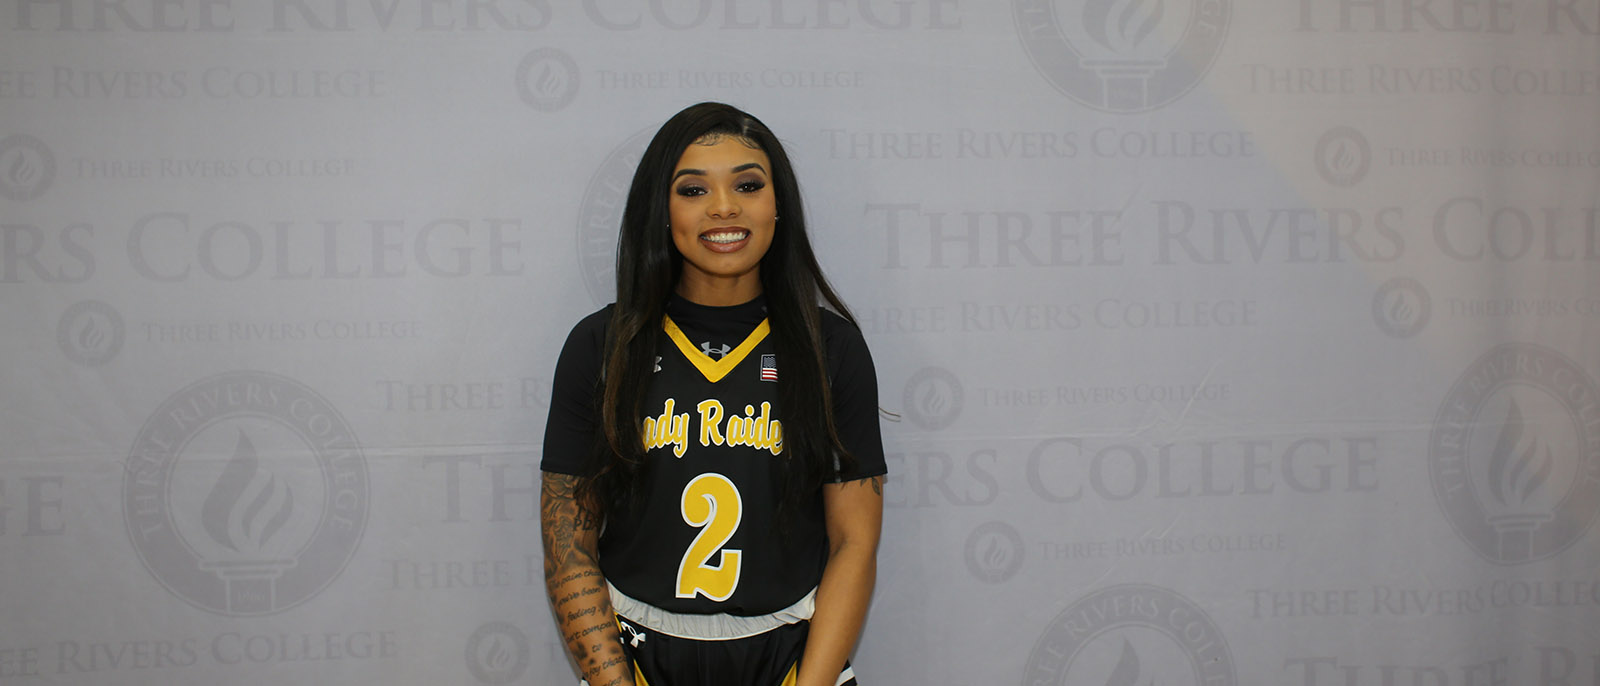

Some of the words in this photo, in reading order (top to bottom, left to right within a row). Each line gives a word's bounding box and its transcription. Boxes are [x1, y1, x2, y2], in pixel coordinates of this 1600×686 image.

[10, 0, 236, 33] HREE
[52, 66, 189, 100] RIVERS
[201, 66, 386, 99] COLLEGE
[596, 69, 670, 90] THREE
[677, 69, 754, 90] RIVERS
[760, 68, 865, 89] COLLEGE
[1242, 63, 1356, 95] THREE
[1367, 64, 1482, 96] RIVERS
[1490, 64, 1600, 97] COLLE
[819, 128, 943, 160] THREE
[955, 128, 1079, 160] RIVERS
[1089, 126, 1255, 159] COLLEGE
[1383, 146, 1451, 167] THREE
[72, 157, 152, 180] THREE
[159, 156, 240, 180] RIVERS
[246, 155, 356, 179] COLLEGE
[126, 211, 526, 284] COLLEGE
[863, 201, 1126, 271] THREE
[1151, 200, 1406, 266] RIVERS
[1432, 196, 1600, 263] COLL
[141, 321, 220, 344] THREE
[227, 319, 307, 342] RIVERS
[313, 318, 423, 341] COLLEGE
[857, 305, 946, 335] HREE
[960, 301, 1082, 332] RIVERS
[1093, 298, 1258, 330] COLLEGE
[170, 382, 282, 431] RIVERS
[376, 380, 504, 412] THREE
[978, 386, 1050, 408] THREE
[1056, 384, 1128, 406] RIVERS
[1133, 382, 1232, 403] COLLEGE
[643, 398, 690, 459] ady
[697, 399, 784, 456] Raide
[883, 448, 1000, 510] ERS
[1025, 436, 1380, 504] COLLEGE
[675, 472, 743, 602] 2
[1039, 540, 1109, 561] THREE
[1115, 537, 1186, 558] RIVERS
[1191, 533, 1286, 555] COLLEGE
[381, 557, 511, 591] THREE
[1246, 588, 1359, 619] THREE
[1371, 584, 1486, 617] RIVERS
[1489, 579, 1600, 608] COLLE
[1064, 594, 1160, 641] RIVERS
[55, 638, 198, 675] RIVERS
[210, 630, 399, 665] COLLEGE
